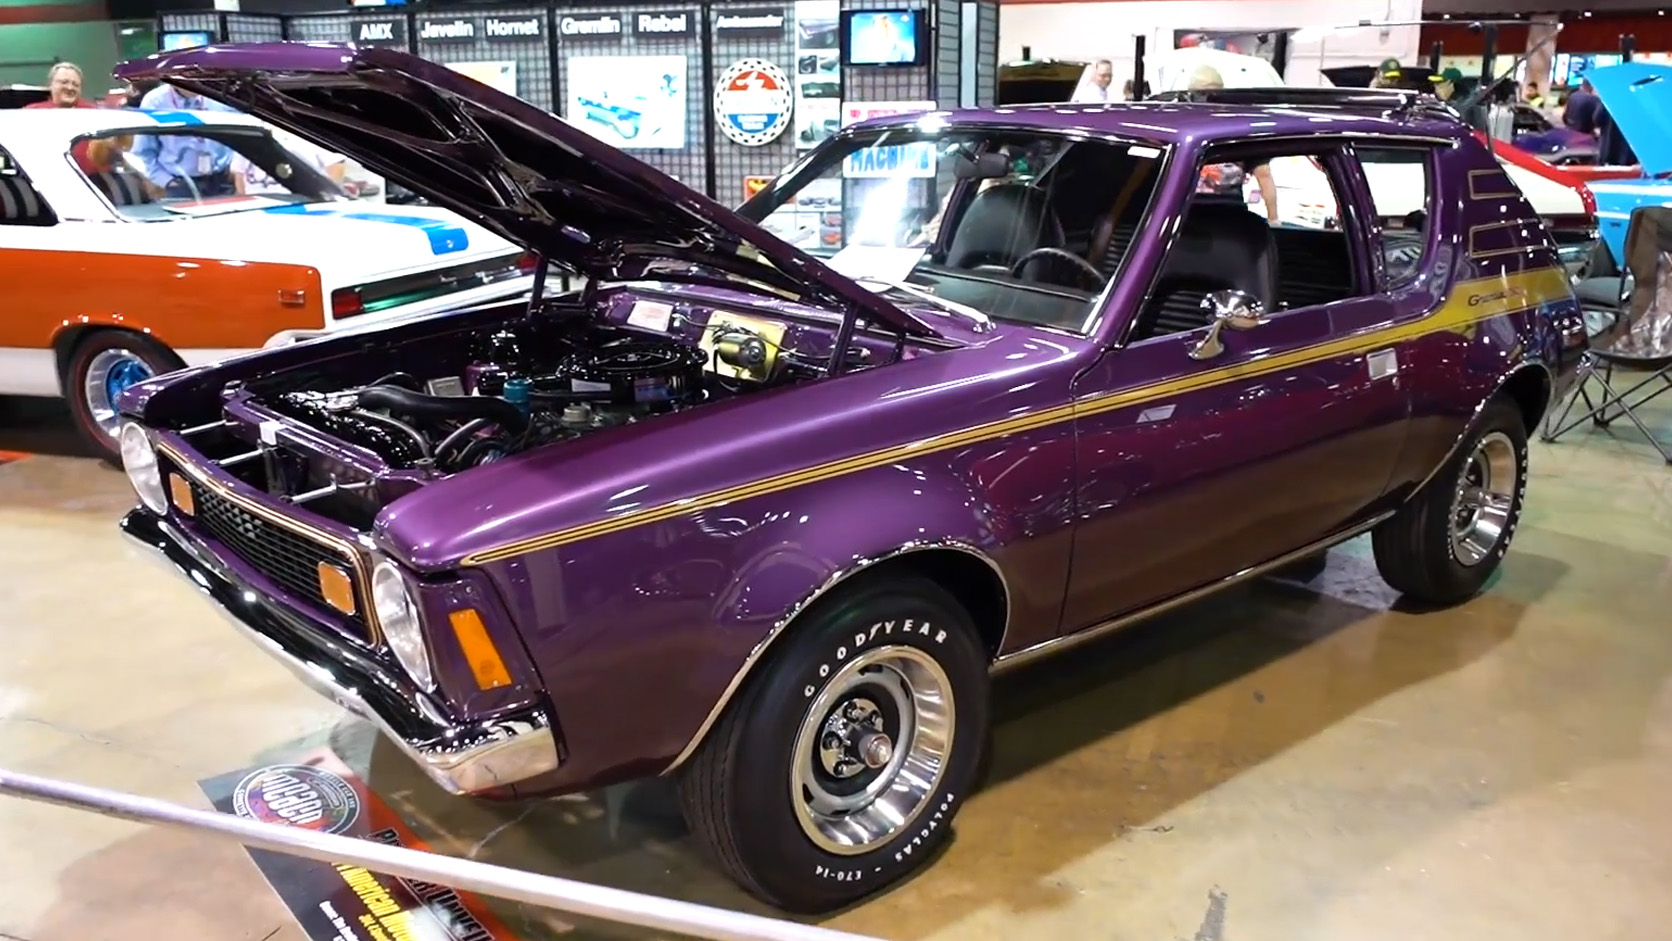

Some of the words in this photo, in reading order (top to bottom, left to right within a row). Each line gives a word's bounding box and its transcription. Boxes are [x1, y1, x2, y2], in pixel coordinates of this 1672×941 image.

[359, 22, 394, 41] AMX
[420, 20, 474, 39] Javelin
[486, 16, 540, 37] Hornet
[561, 15, 621, 36] Gremlin
[639, 14, 687, 32] Rebel
[804, 618, 949, 698] GOODYEAR
[894, 793, 955, 862] POLYGLAS
[815, 864, 862, 882] E70-14
